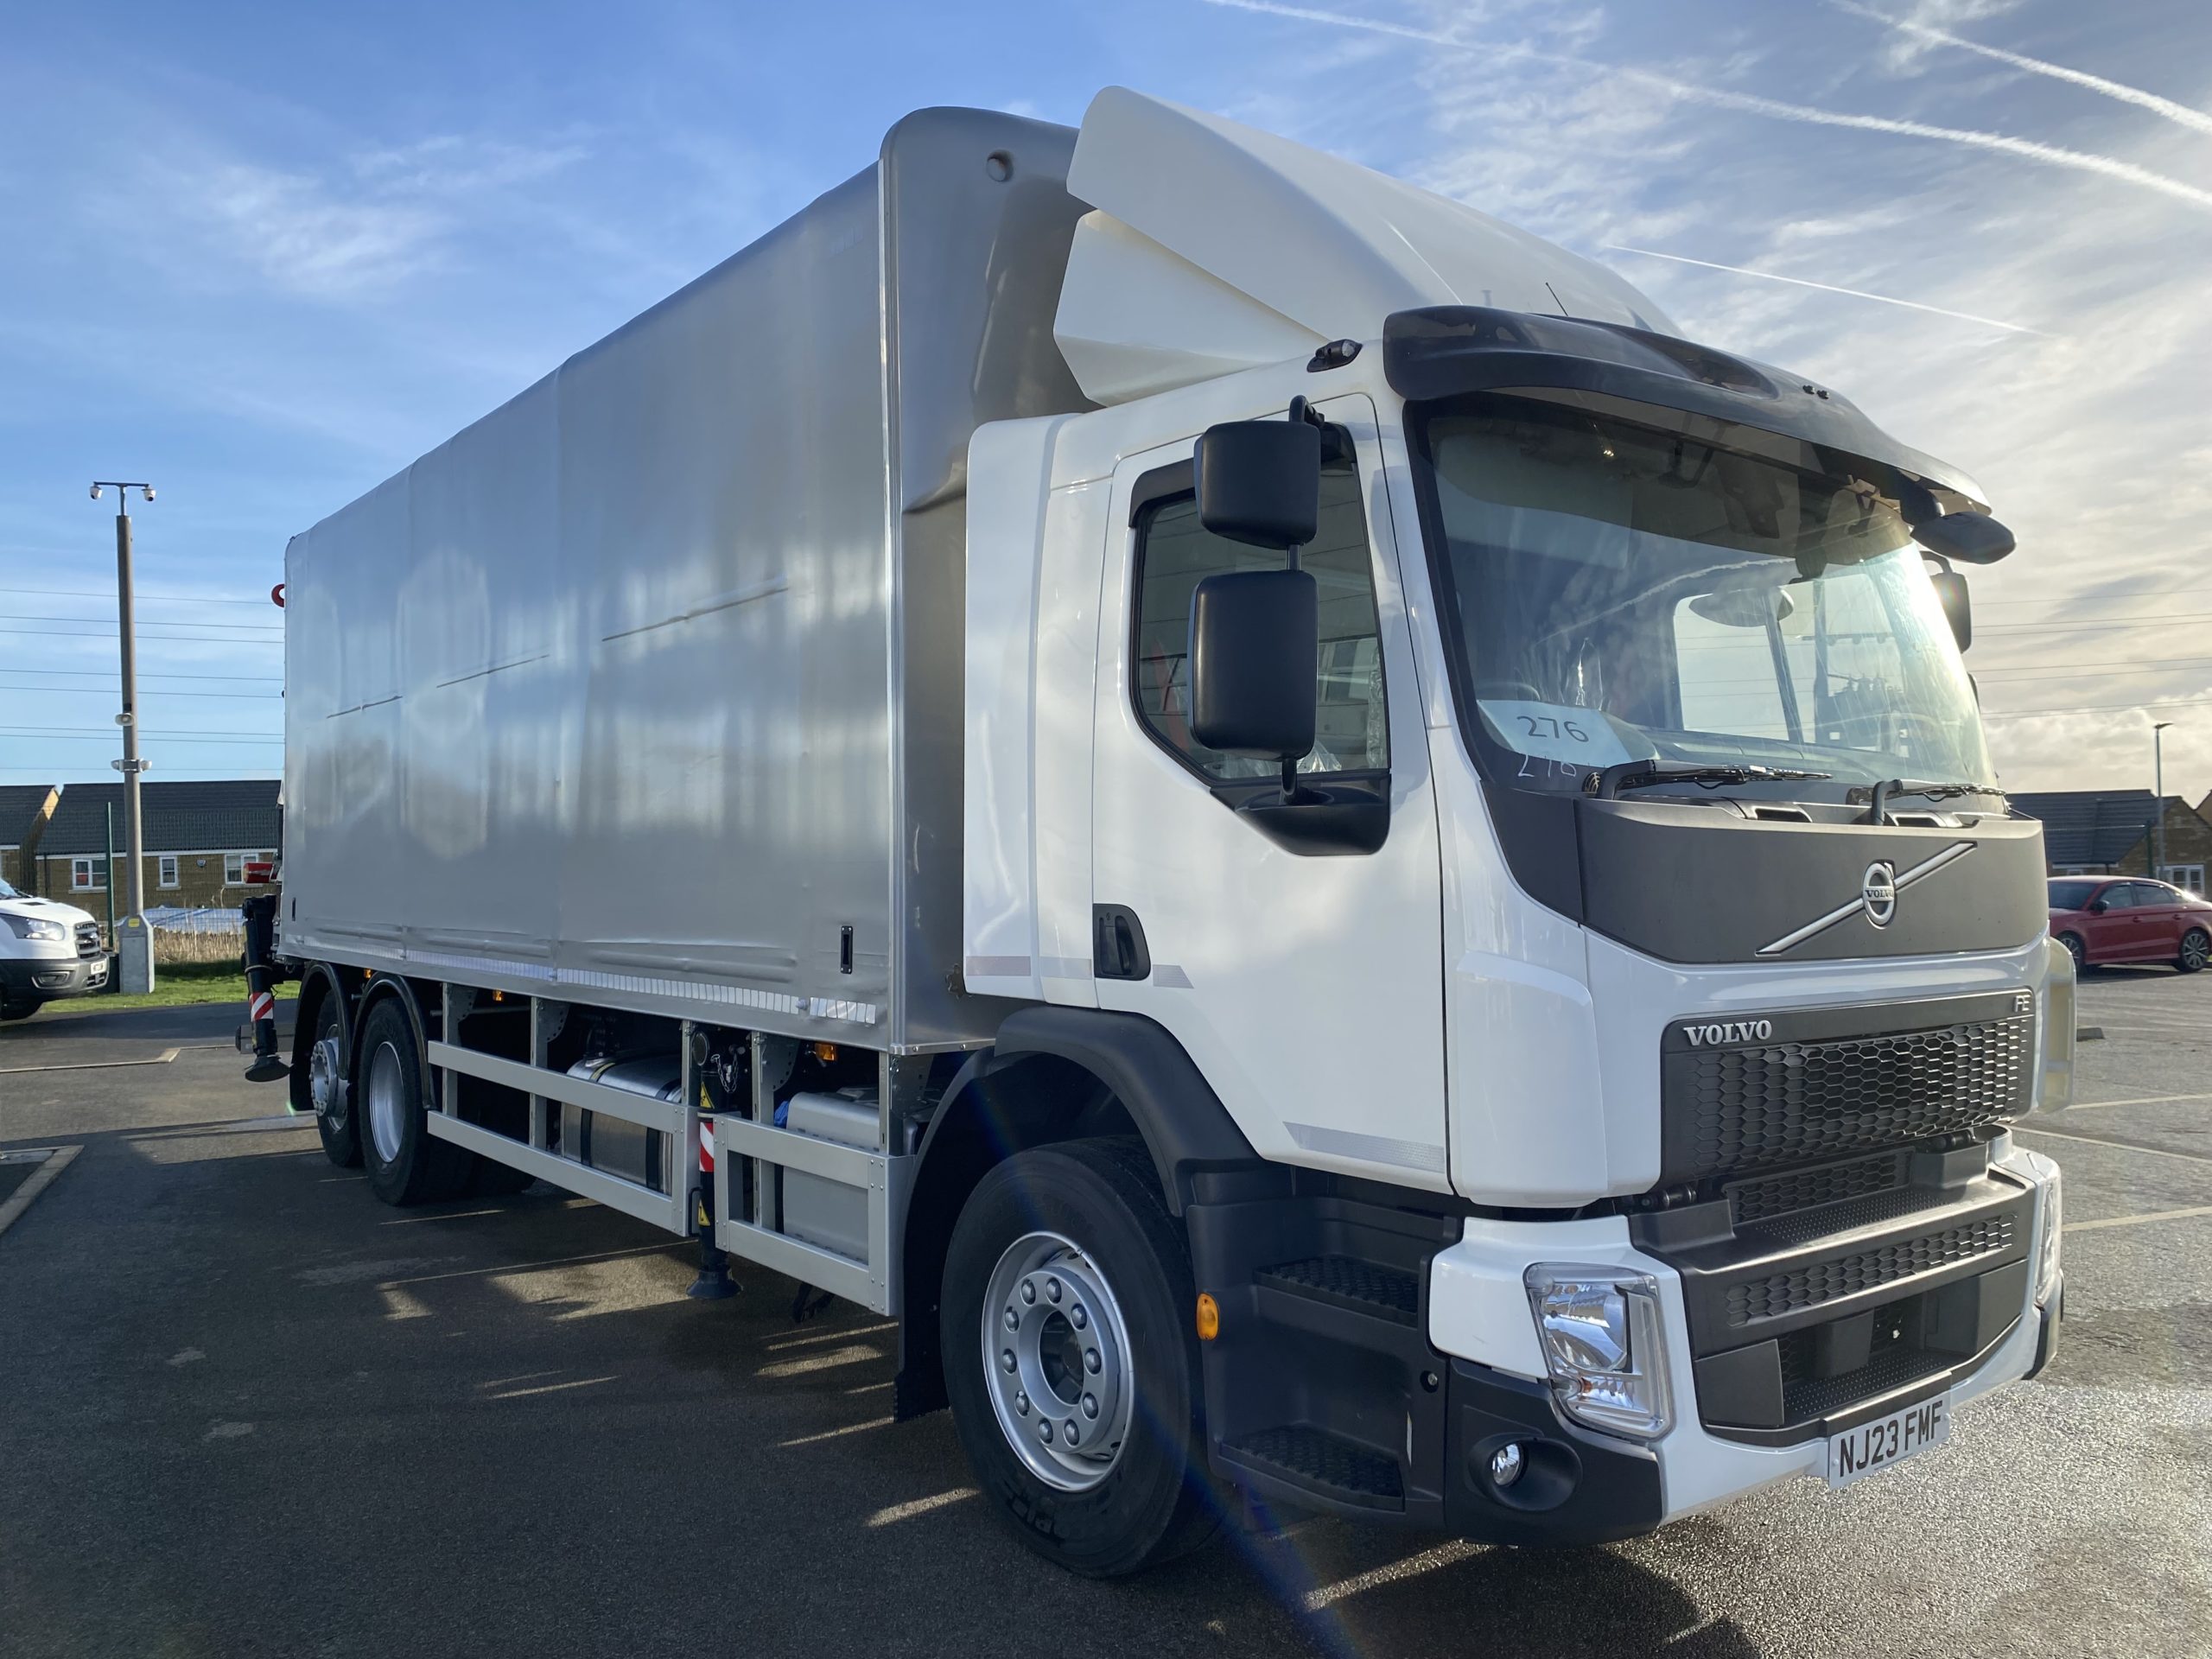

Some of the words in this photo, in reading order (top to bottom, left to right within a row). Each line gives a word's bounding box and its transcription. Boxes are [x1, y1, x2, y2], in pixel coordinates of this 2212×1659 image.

[1516, 715, 1589, 742] 276
[1865, 889, 1894, 899] VOLVO
[2015, 995, 2031, 1012] FE
[1683, 1020, 1772, 1046] VOLVO
[1840, 1419, 1898, 1478] NJ23
[1904, 1400, 1943, 1451] FMF
